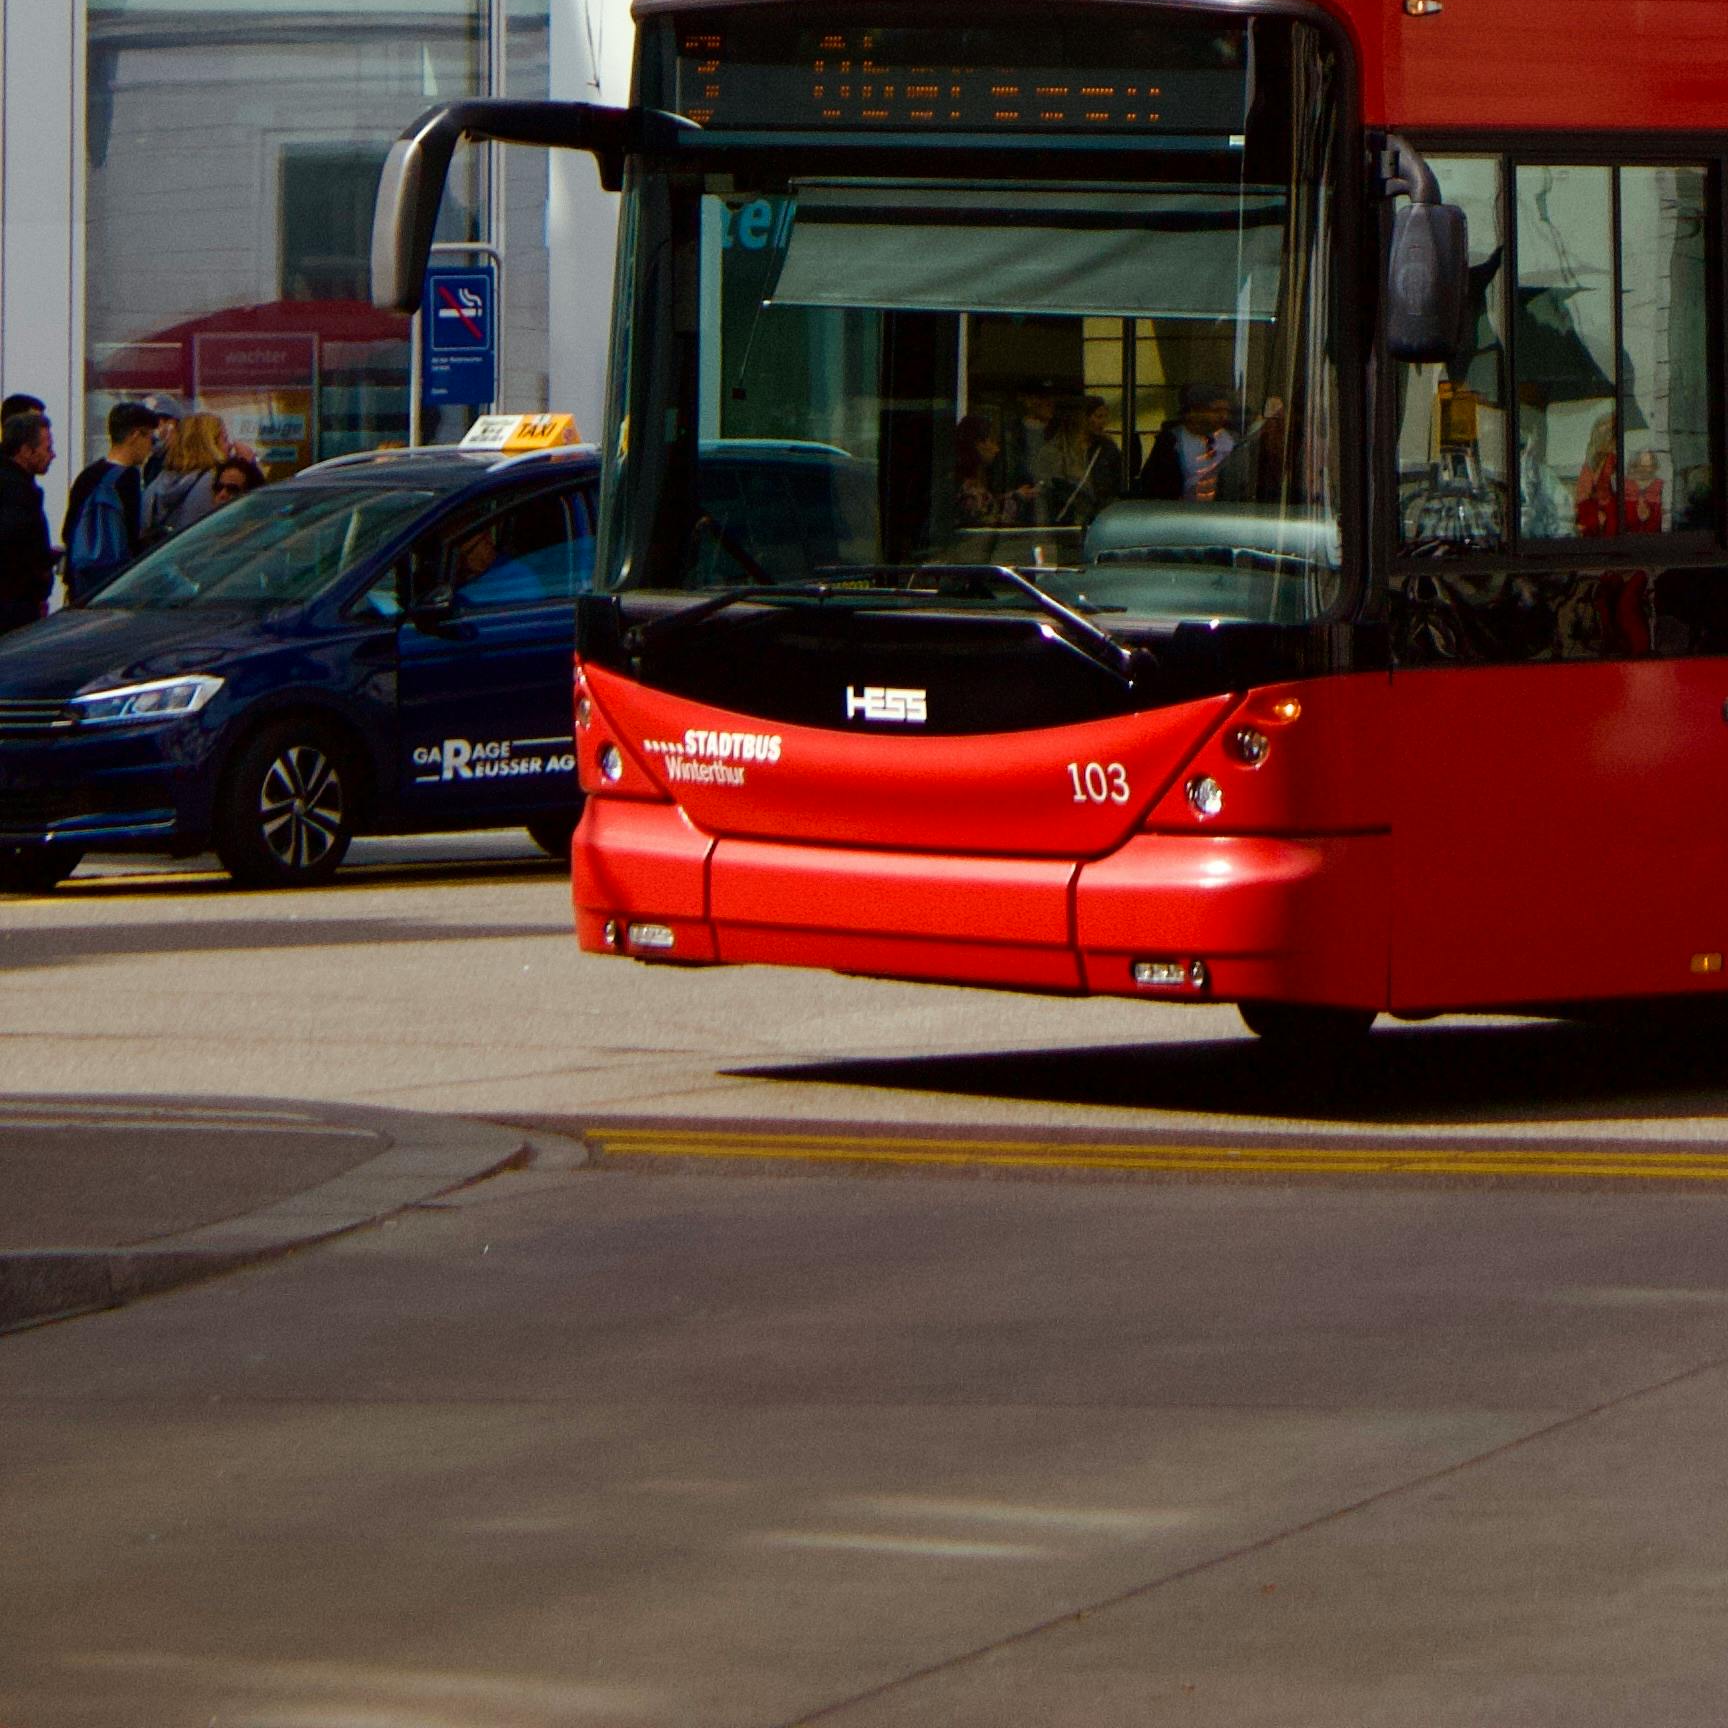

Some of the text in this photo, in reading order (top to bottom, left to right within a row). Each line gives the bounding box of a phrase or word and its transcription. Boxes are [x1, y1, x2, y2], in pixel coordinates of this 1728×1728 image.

[517, 422, 558, 439] TAXI
[845, 685, 927, 723] HESS
[684, 728, 782, 763] STADTBUS
[545, 754, 576, 773] AG
[665, 755, 745, 787] Winterthur
[1067, 761, 1131, 804] 103
